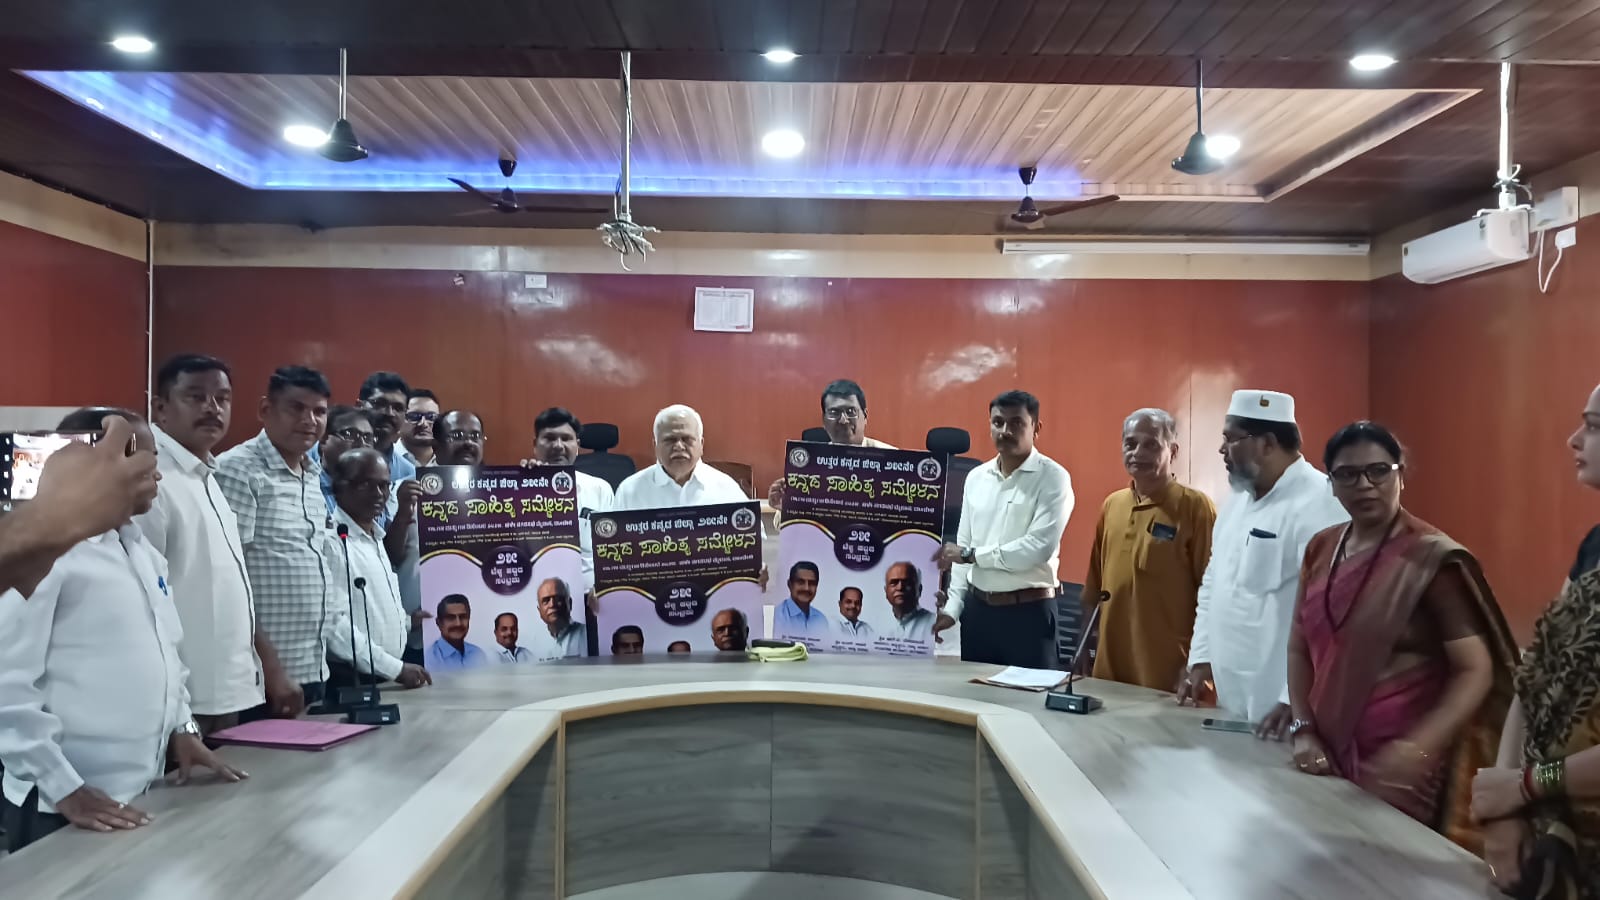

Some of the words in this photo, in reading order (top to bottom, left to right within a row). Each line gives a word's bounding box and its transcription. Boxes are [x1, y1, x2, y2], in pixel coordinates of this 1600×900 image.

[816, 456, 839, 470] ಉತ್ತರ
[840, 457, 860, 471] ಕನ್ನಡ
[862, 459, 881, 473] ಜಿಲ್ಲಾ
[477, 478, 497, 492] ಕನ್ನಡ
[499, 478, 519, 491] ಜಿಲ್ಲಾ
[787, 472, 821, 495] ಕನ್ನಡ
[826, 474, 875, 499] ಸಾಹಿತ್ಯ
[881, 478, 941, 503] ಸಮ್ಮೇಳನ
[421, 500, 459, 522] ಕನ್ನಡ
[465, 495, 516, 518] ಸಾಹಿತ್ಯ
[520, 494, 575, 518] ಸಮ್ಮೇಳನ
[625, 521, 649, 535] ಉತ್ತರ
[651, 520, 672, 533] ಕನ್ನಡ
[674, 519, 695, 530] ಜಿಲ್ಲಾ
[596, 542, 633, 563] ಕನ್ನಡ
[638, 535, 692, 557] ಸಾಹಿತ್ಯ
[696, 532, 757, 555] ಸಮ್ಮೇಳನ
